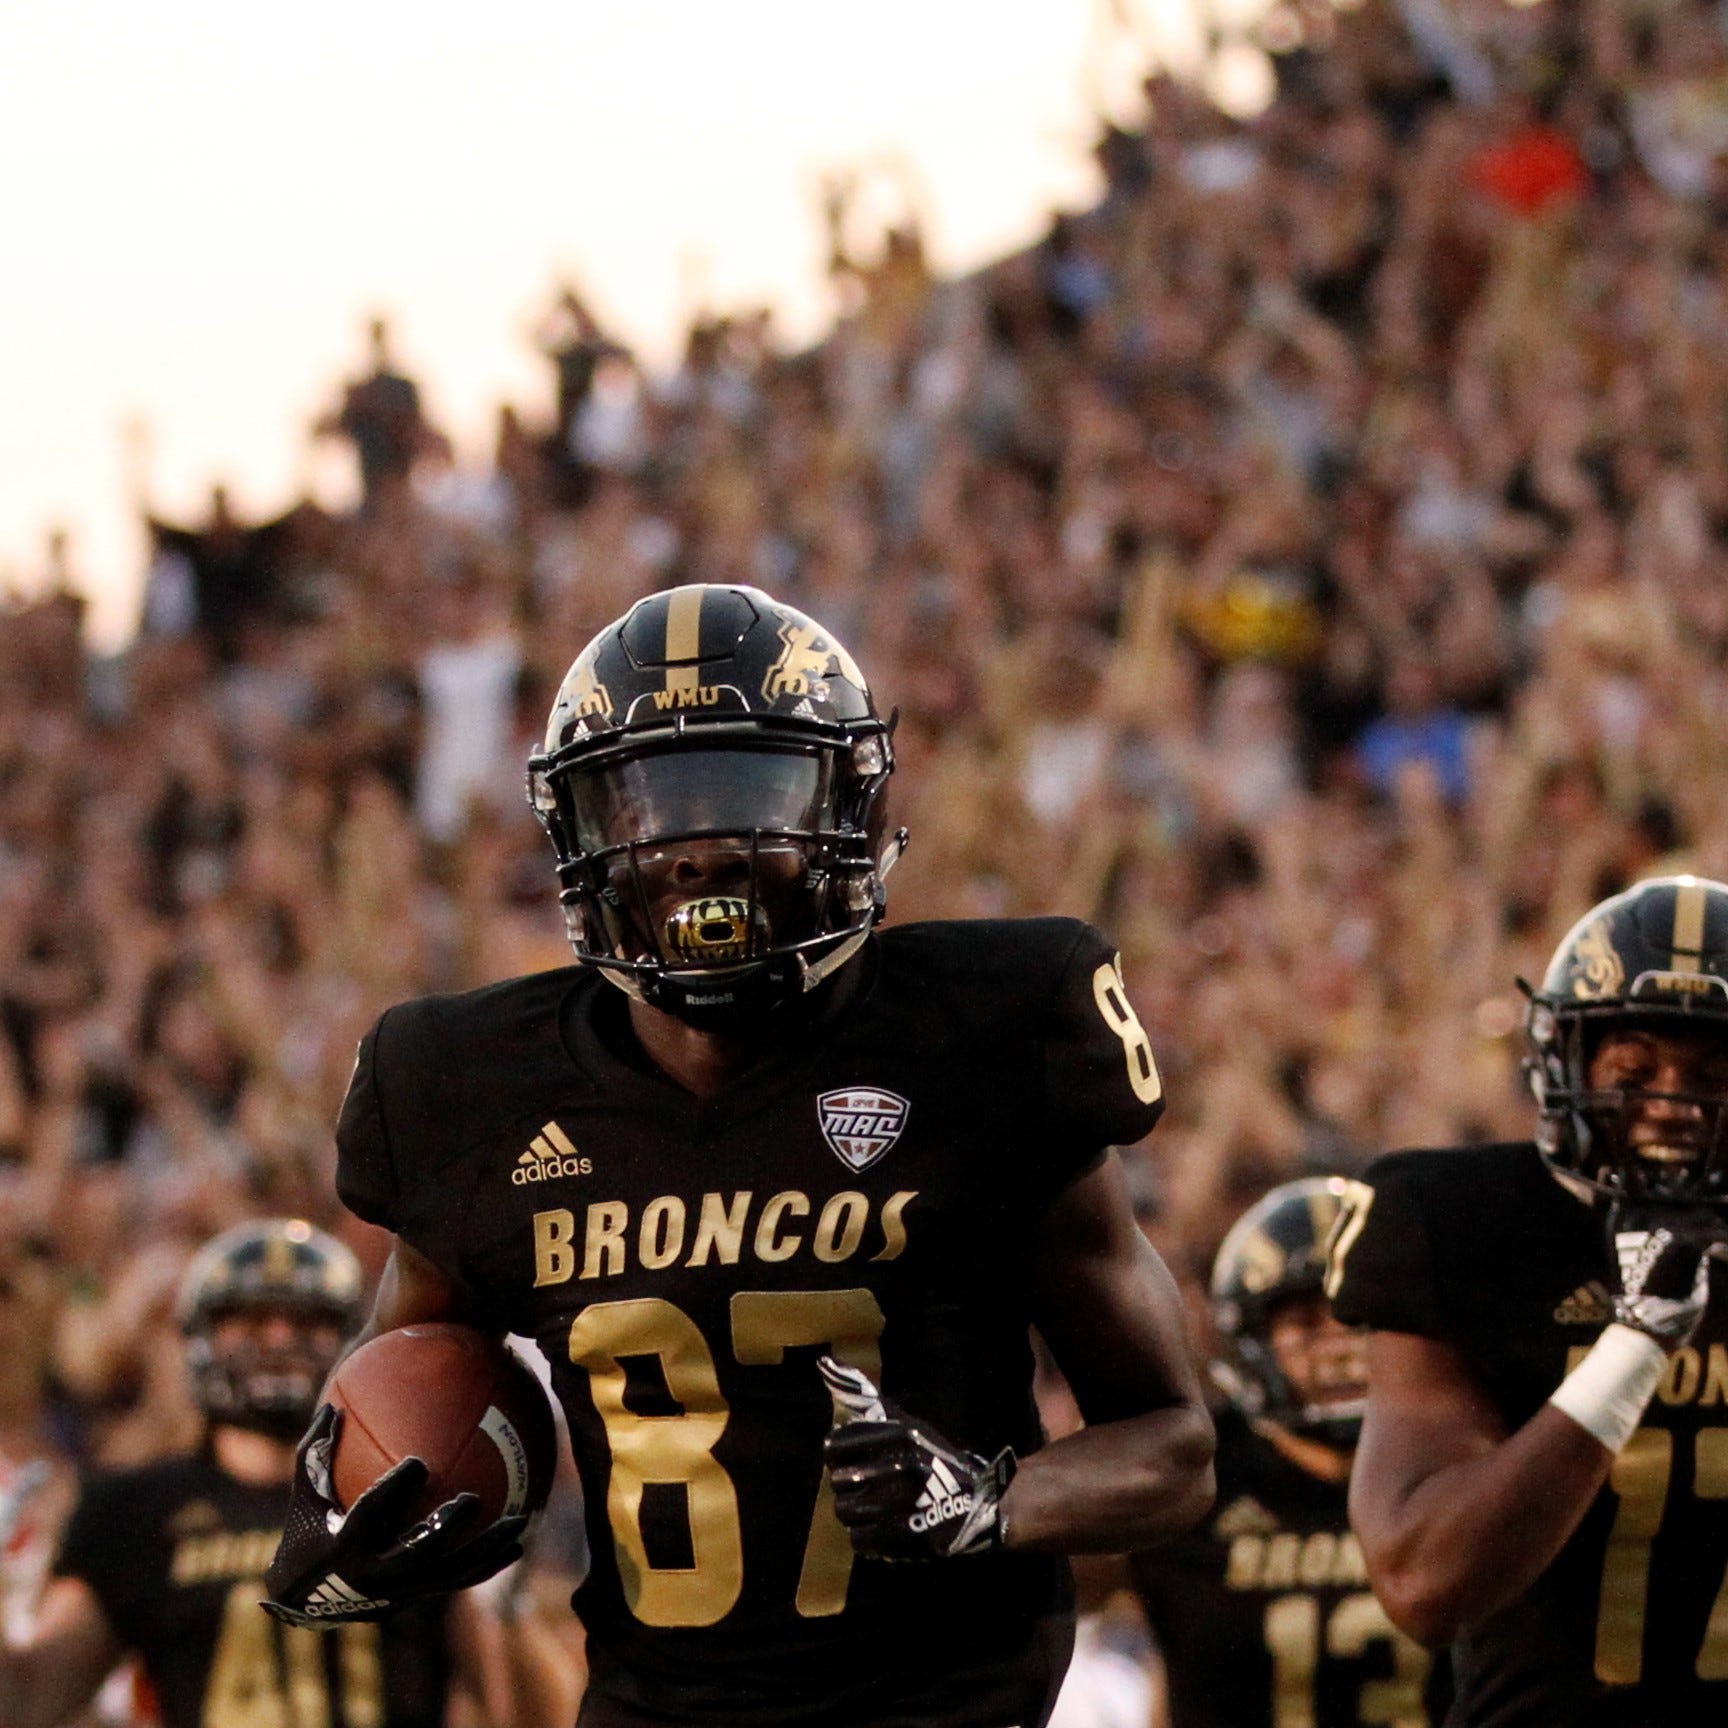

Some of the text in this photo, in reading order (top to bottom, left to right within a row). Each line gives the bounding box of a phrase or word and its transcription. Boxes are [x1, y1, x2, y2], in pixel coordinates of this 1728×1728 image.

[653, 686, 719, 710] WMU
[1092, 951, 1162, 1105] 8
[824, 1112, 900, 1137] MAC
[511, 1155, 593, 1185] adidas
[533, 1191, 920, 1289] BRONCOS
[569, 1288, 887, 1628] 87
[909, 1491, 973, 1533] adidas
[304, 1599, 390, 1617] adidas
